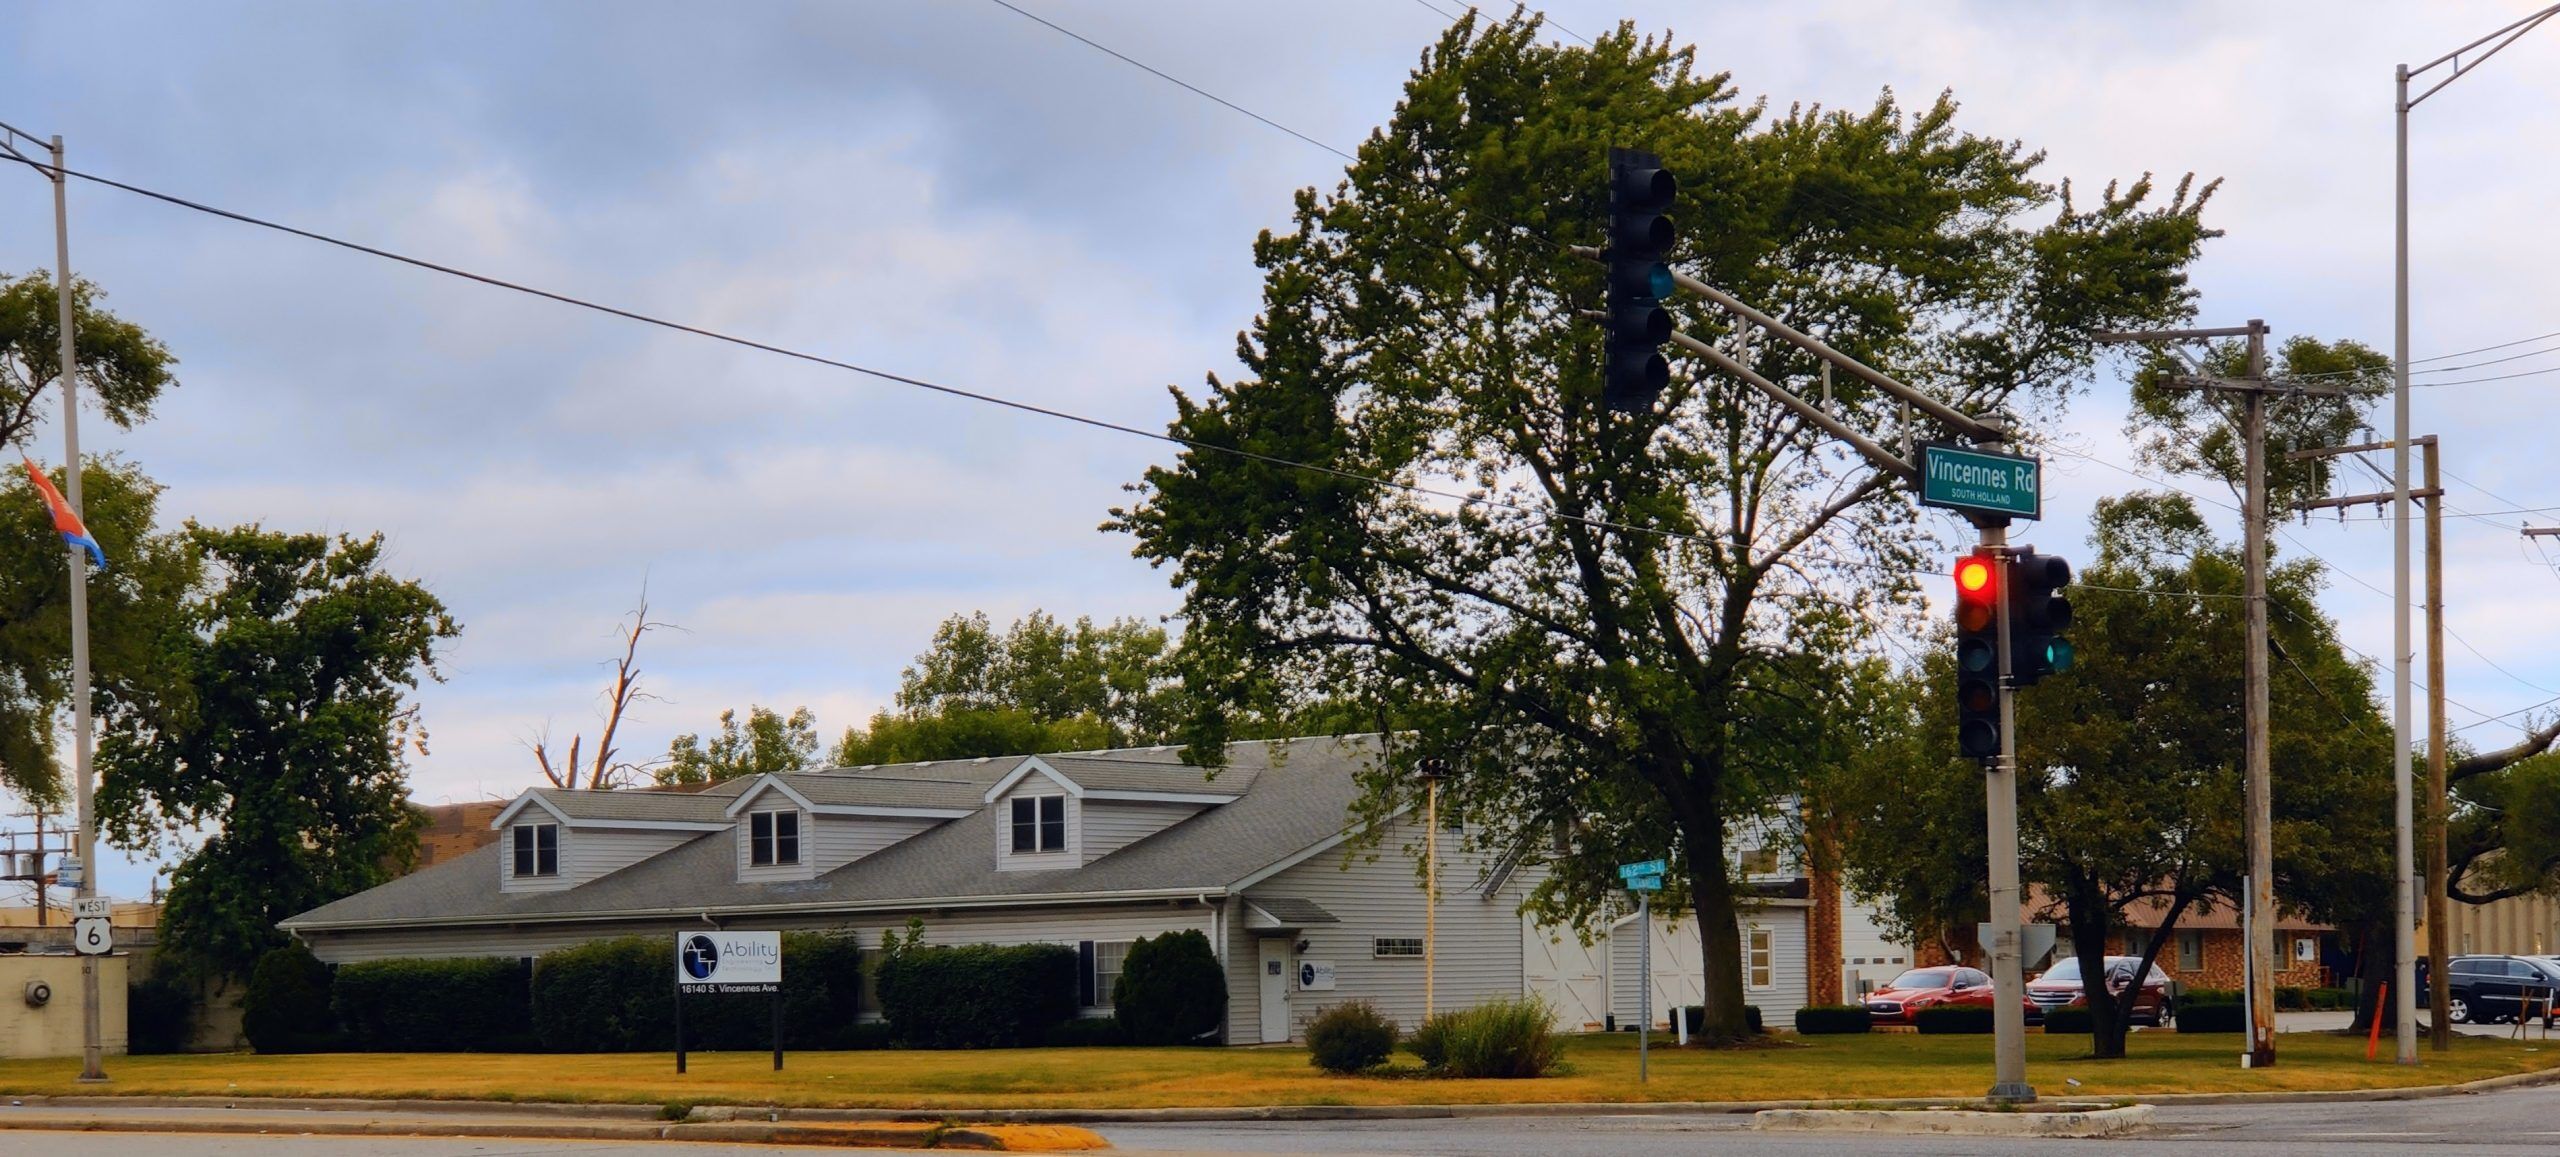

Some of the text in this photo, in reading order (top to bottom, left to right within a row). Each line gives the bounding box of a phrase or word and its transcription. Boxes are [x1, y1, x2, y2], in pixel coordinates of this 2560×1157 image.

[1929, 453, 2034, 493] Vincennes Rd
[1952, 488, 2010, 504] SOUTH HOLLAND
[78, 900, 106, 913] WEST
[88, 926, 100, 946] 6
[722, 941, 778, 965] Ability
[682, 983, 779, 994] 16140 S. Vincennes Ave.
